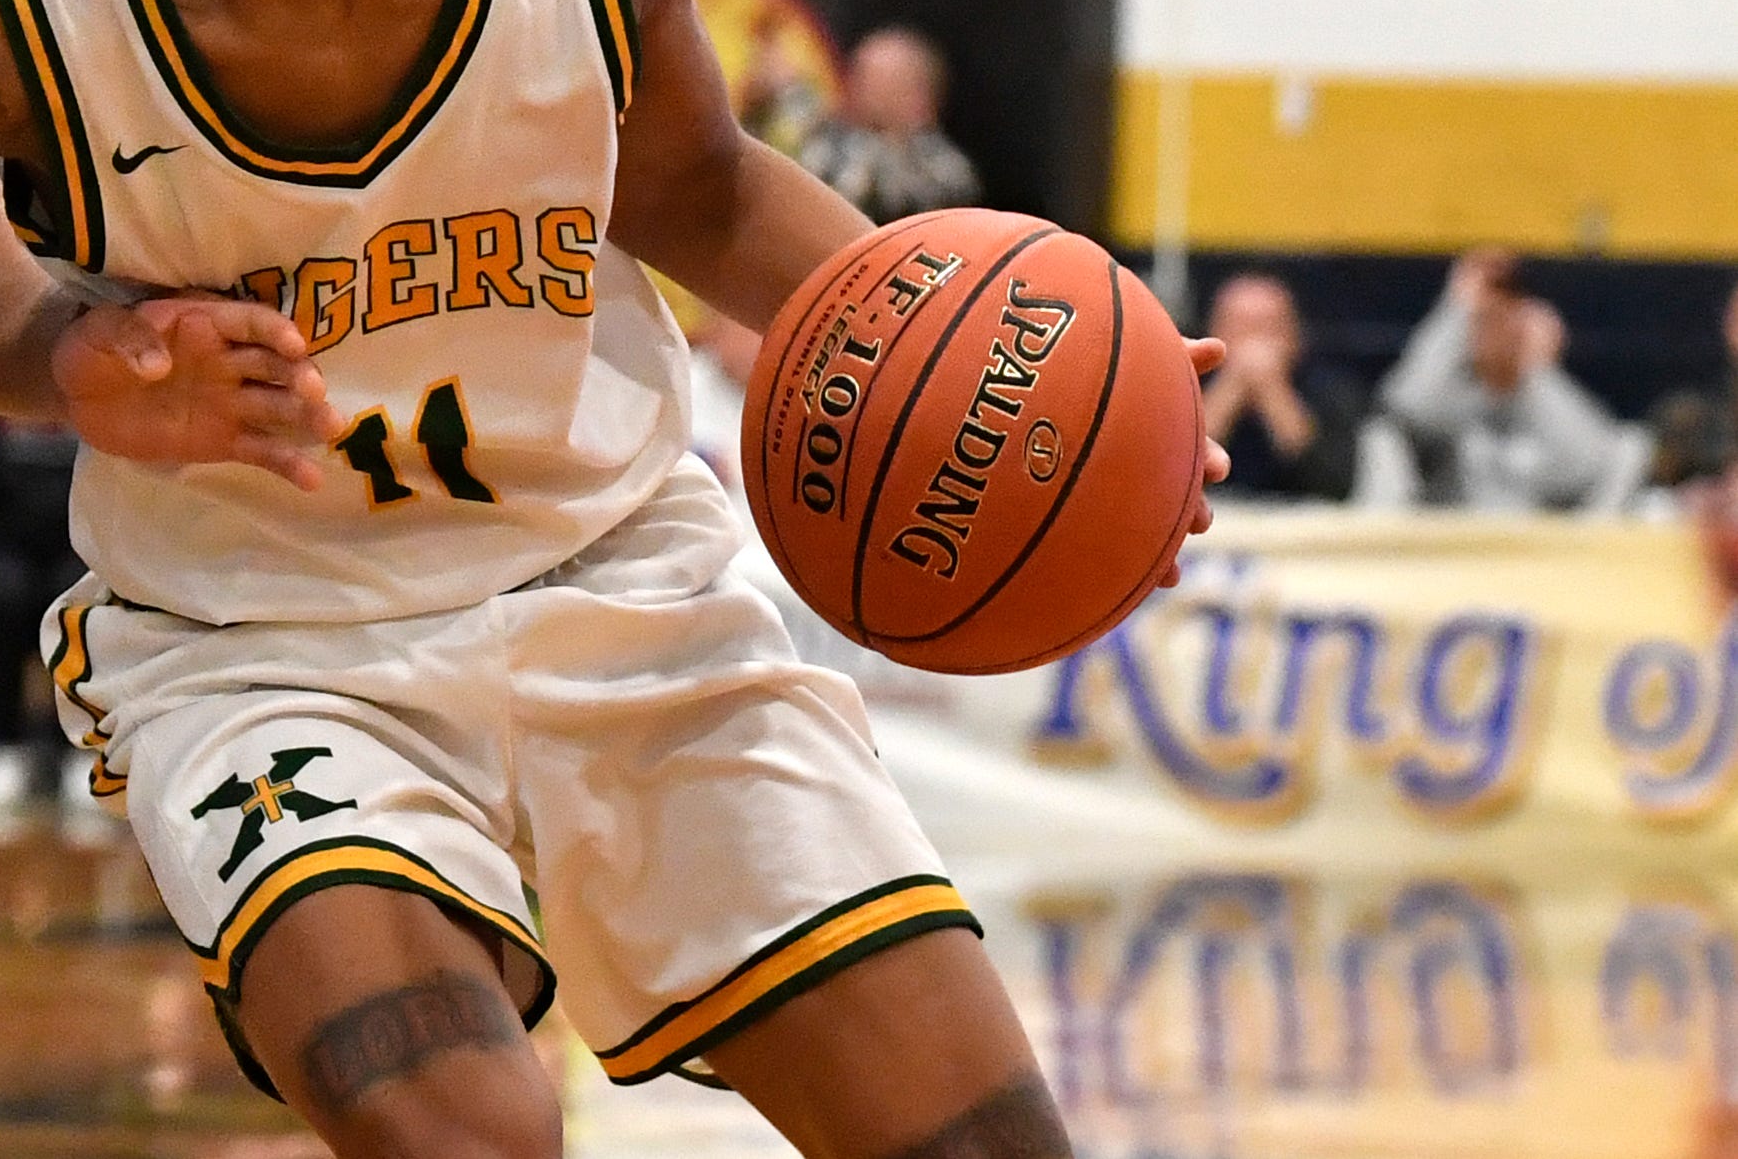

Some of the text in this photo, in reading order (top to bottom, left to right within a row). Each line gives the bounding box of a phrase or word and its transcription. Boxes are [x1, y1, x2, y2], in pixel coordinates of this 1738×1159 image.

[239, 205, 598, 357] GERS
[799, 303, 858, 415] LEGACY
[888, 276, 1077, 582] SPALDING
[329, 375, 500, 511] 11
